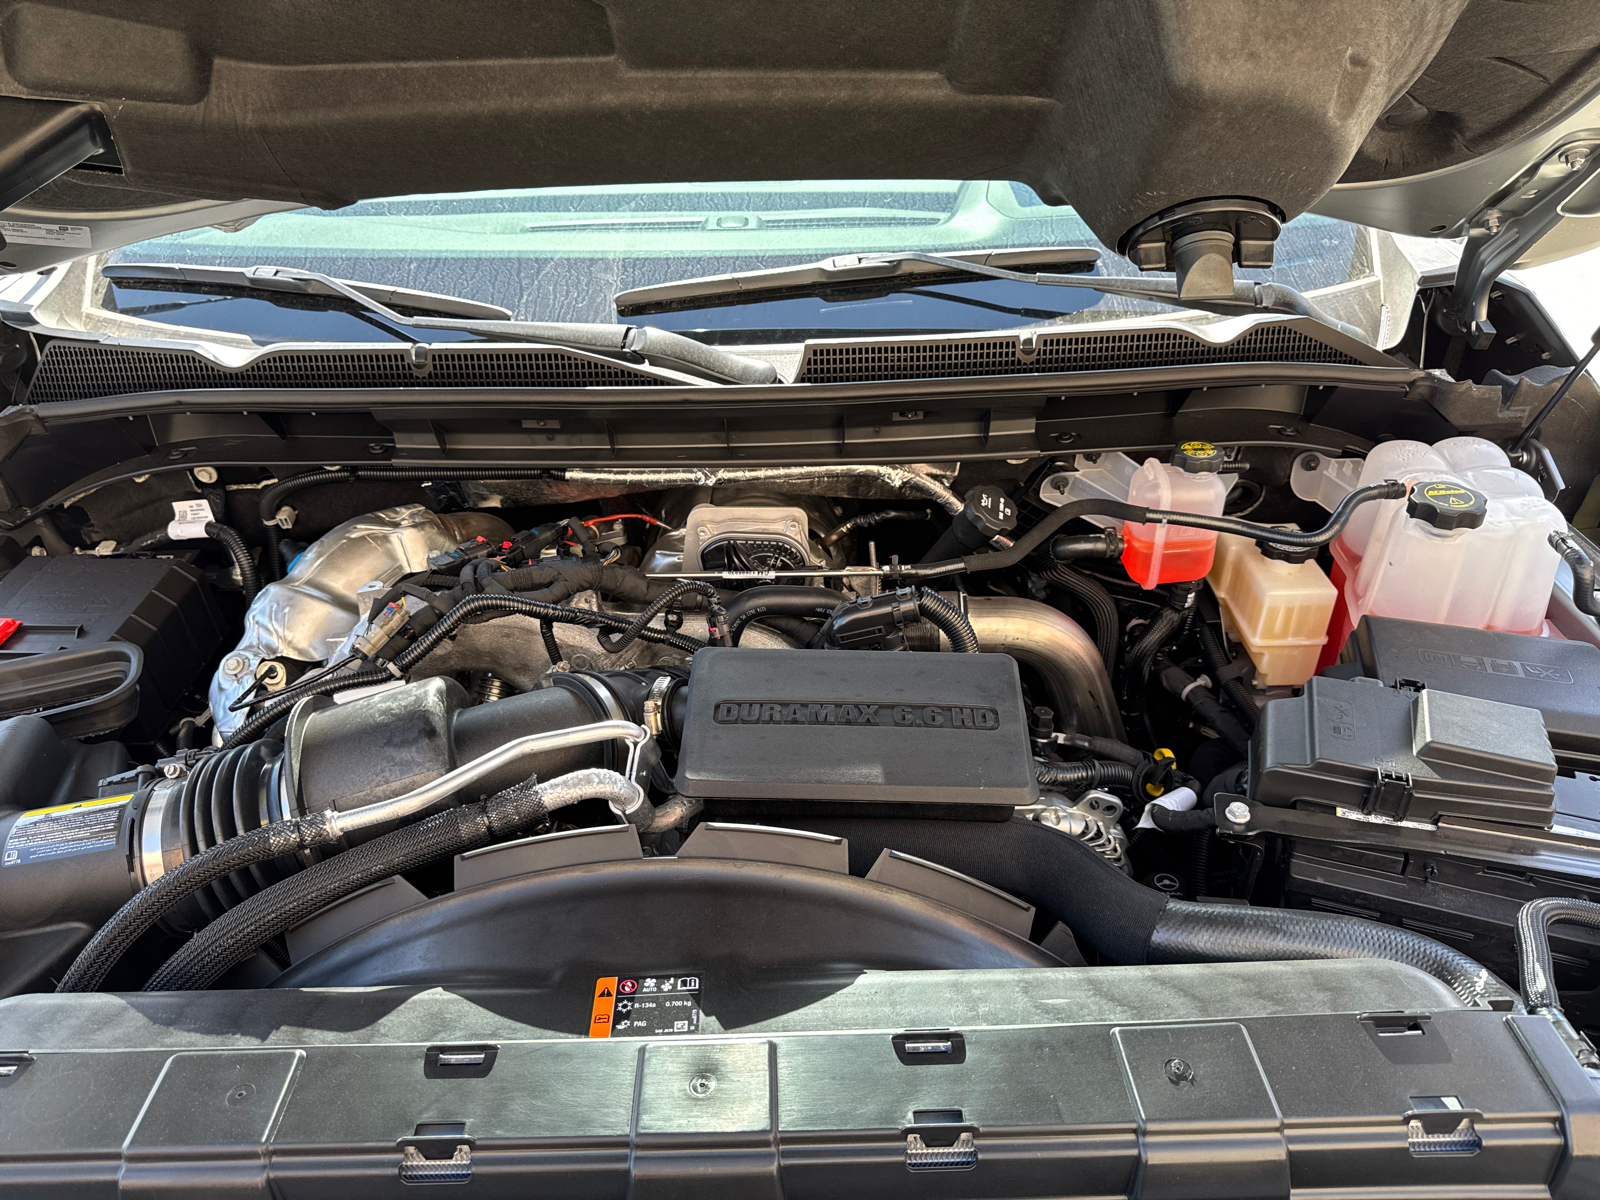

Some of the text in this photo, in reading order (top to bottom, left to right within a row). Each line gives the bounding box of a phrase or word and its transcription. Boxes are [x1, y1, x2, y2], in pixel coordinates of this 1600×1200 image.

[717, 703, 998, 728] DURAMAX 6.6 HD
